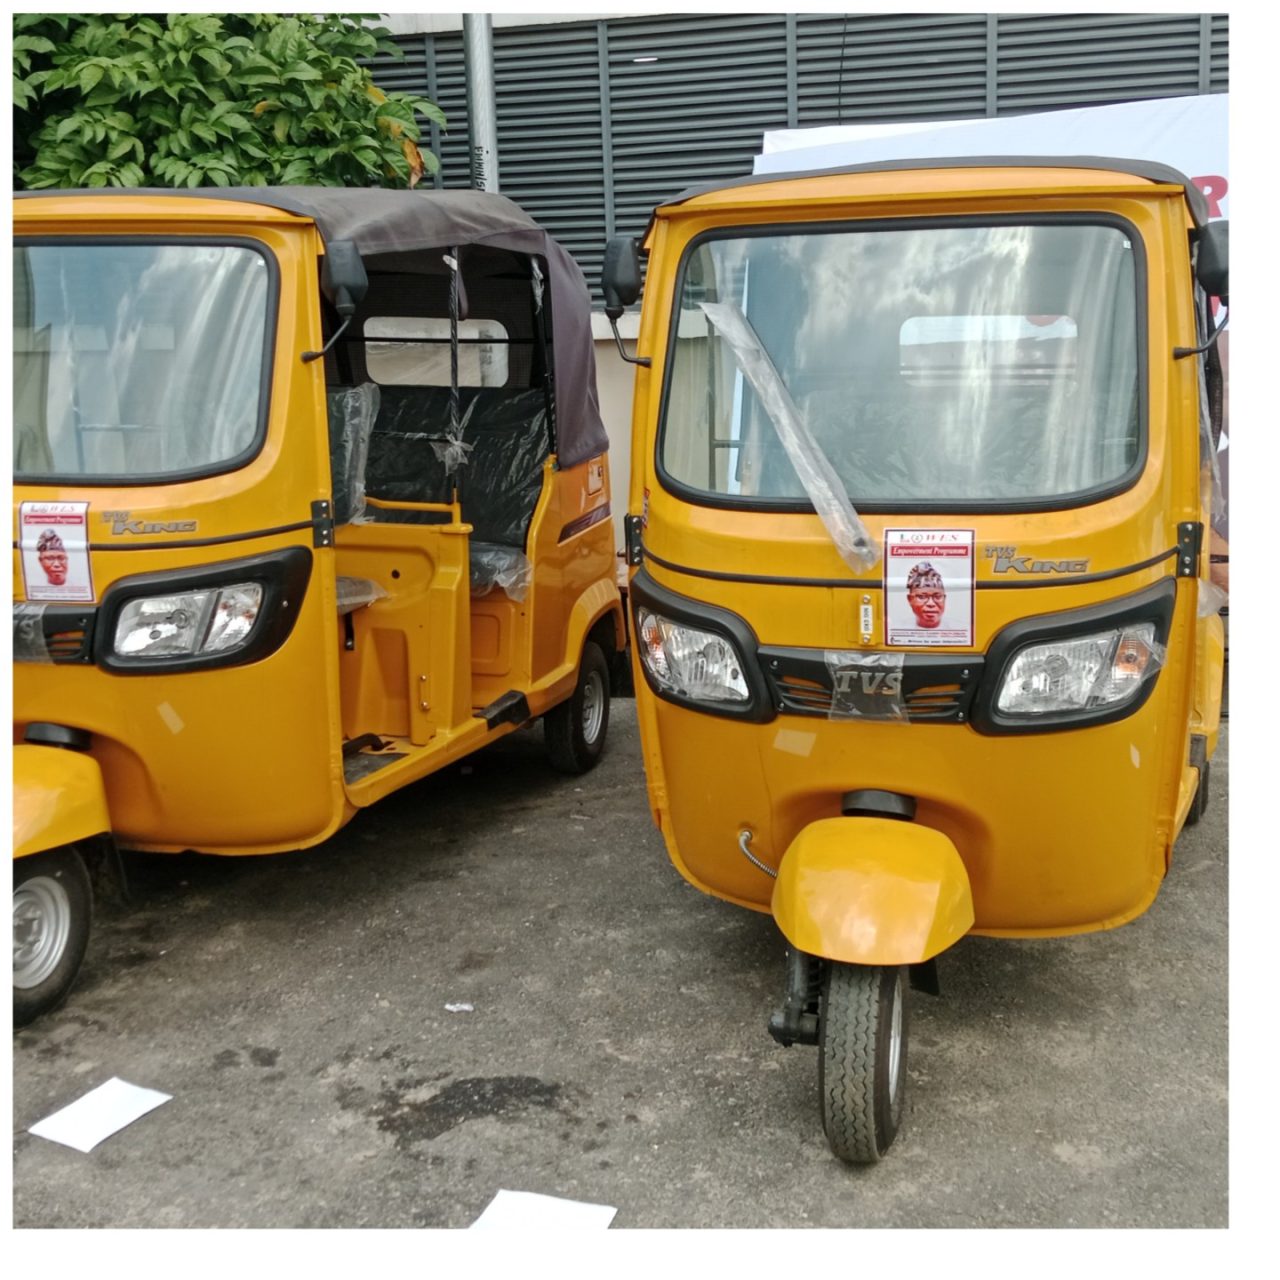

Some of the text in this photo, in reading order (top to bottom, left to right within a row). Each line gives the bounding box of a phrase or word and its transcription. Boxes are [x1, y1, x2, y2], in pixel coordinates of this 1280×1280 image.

[892, 546, 967, 557] Empowerment Programme
[984, 545, 1015, 559] TVS
[835, 671, 904, 695] TVS
